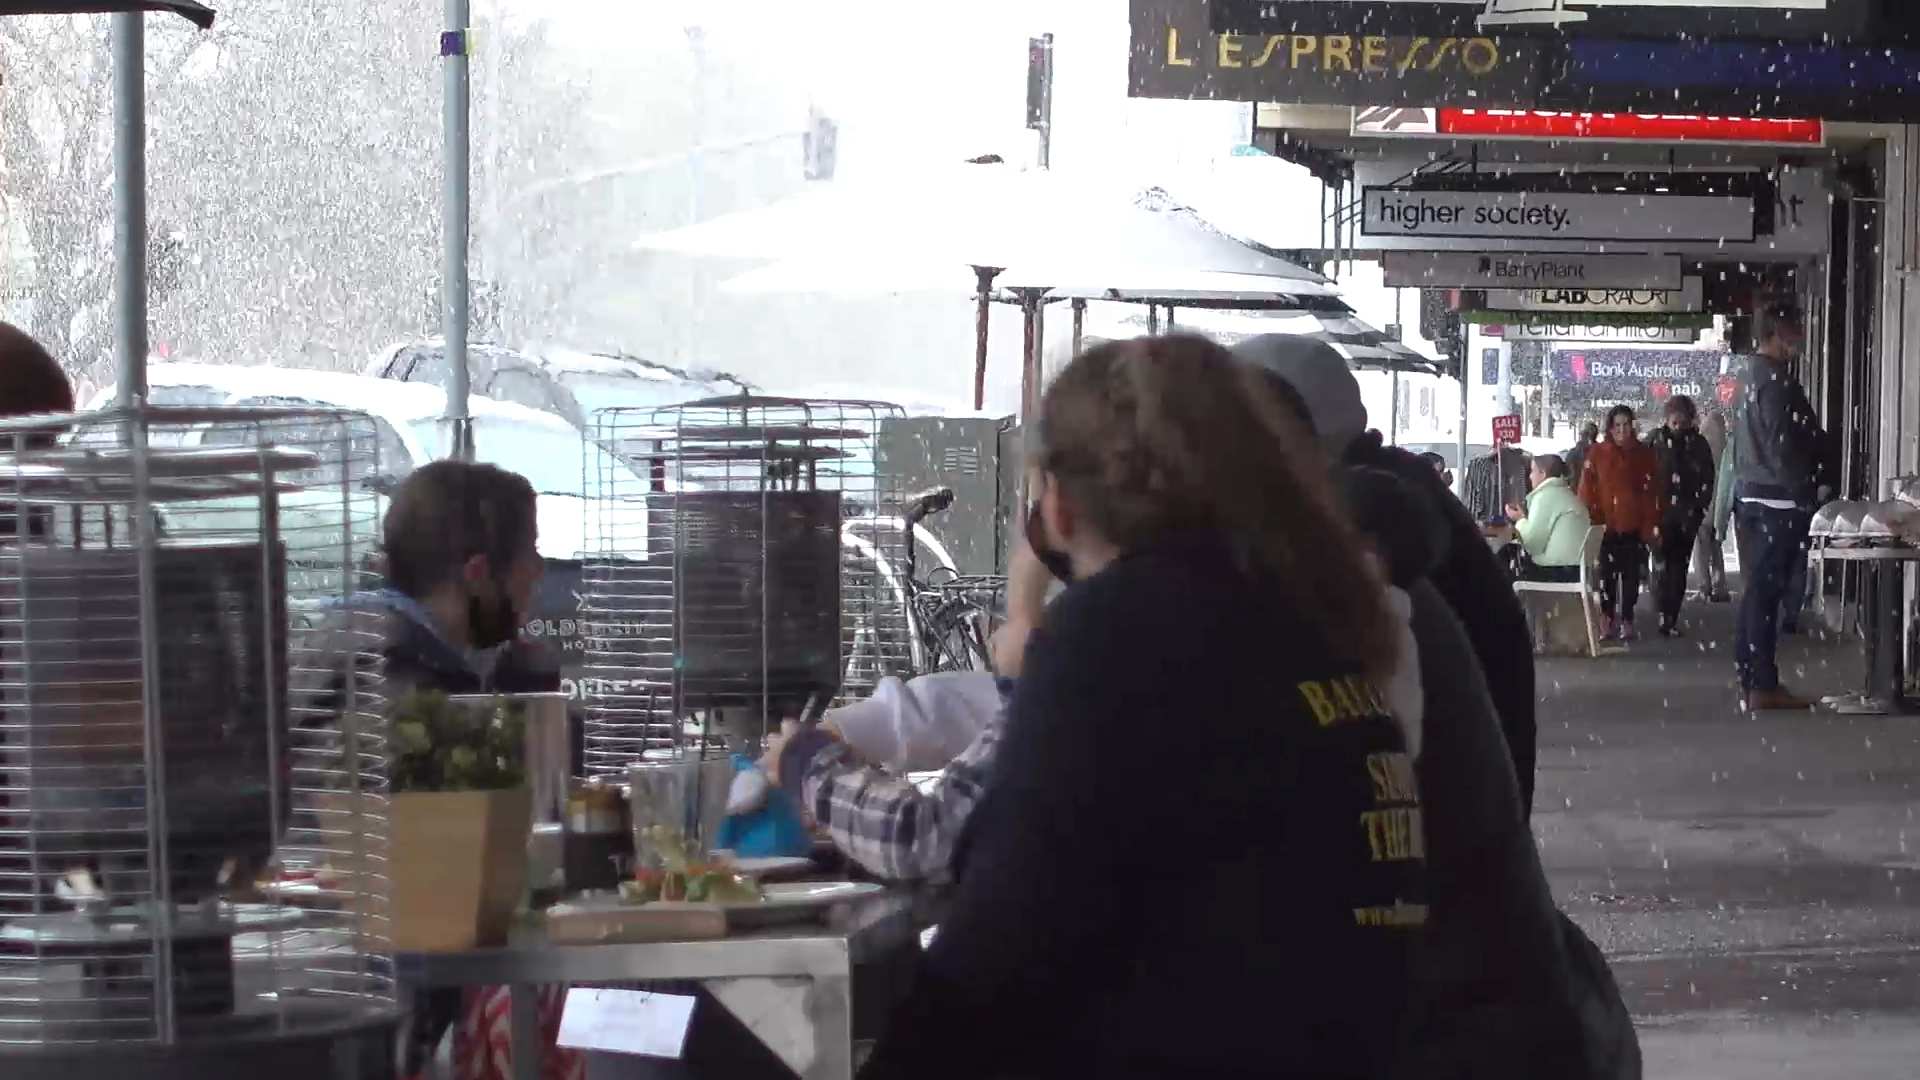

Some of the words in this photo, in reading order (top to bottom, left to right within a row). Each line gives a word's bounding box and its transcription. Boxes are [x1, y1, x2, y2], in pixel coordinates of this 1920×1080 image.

[1218, 33, 1498, 75] ESPRESSO
[1380, 197, 1465, 229] higher
[1475, 202, 1570, 231] society.
[1591, 362, 1625, 377] Bank
[1627, 362, 1688, 378] Australia
[1671, 382, 1701, 396] nab
[1495, 418, 1519, 428] SALE
